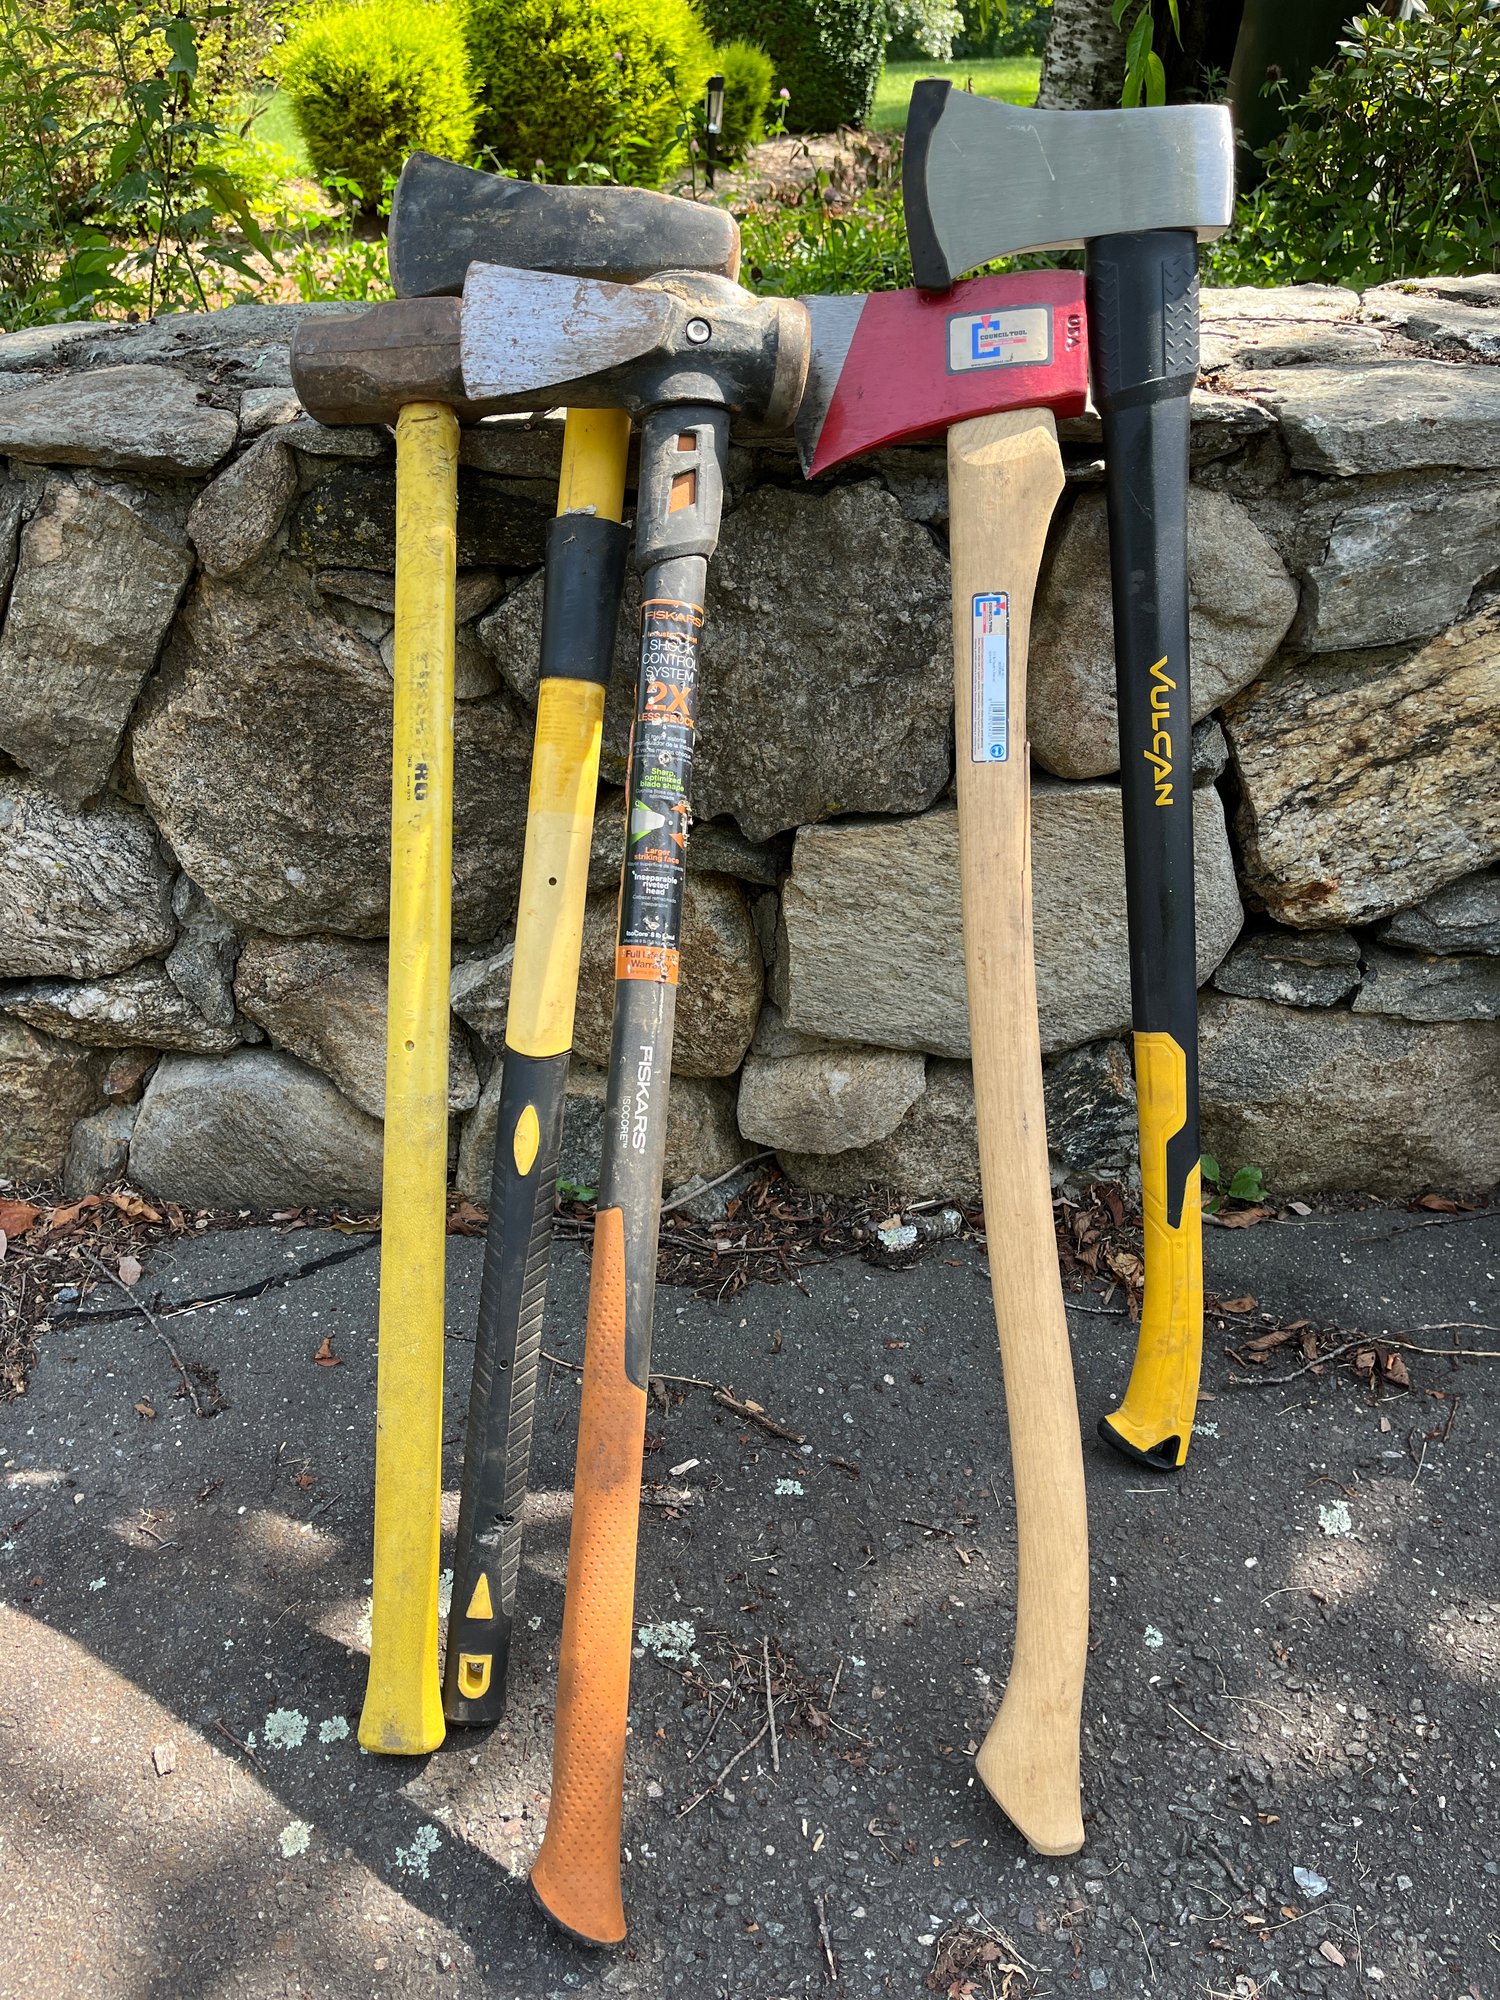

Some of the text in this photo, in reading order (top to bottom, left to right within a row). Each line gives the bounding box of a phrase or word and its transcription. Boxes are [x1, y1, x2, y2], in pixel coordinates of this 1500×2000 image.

[980, 332, 1009, 341] COUNCIL
[645, 610, 703, 628] FISKARS
[649, 639, 695, 656] SHOCK
[642, 653, 698, 672] CONTROL
[645, 666, 695, 683] SYSTEM
[645, 680, 692, 716] 2X
[637, 713, 660, 723] LESS
[661, 714, 695, 729] SHOCK
[1143, 655, 1177, 807] VULCAN
[651, 767, 676, 778] Sharp,
[644, 774, 682, 785] optimized
[639, 780, 685, 792] blade shape
[645, 846, 671, 856] Larger
[634, 853, 682, 865] striking face
[634, 873, 678, 885] Inseparable
[643, 881, 670, 890] riveted
[646, 886, 666, 896] head
[625, 949, 641, 959] Full
